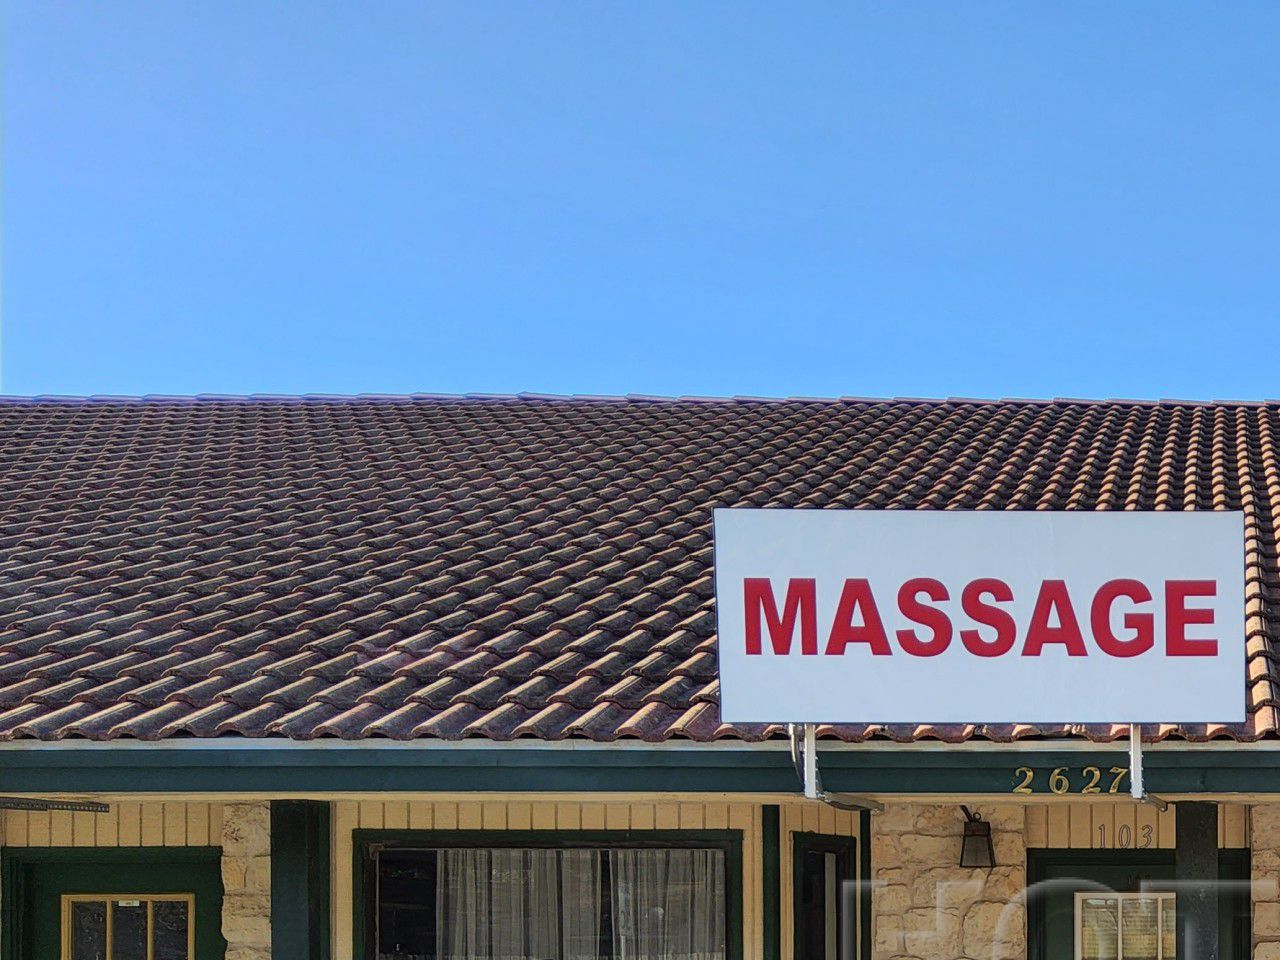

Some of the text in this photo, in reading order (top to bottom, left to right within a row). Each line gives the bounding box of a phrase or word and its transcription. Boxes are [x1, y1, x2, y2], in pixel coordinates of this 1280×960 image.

[743, 577, 1219, 658] MASSAGE
[1012, 766, 1129, 794] 2627
[1098, 824, 1154, 849] 103
